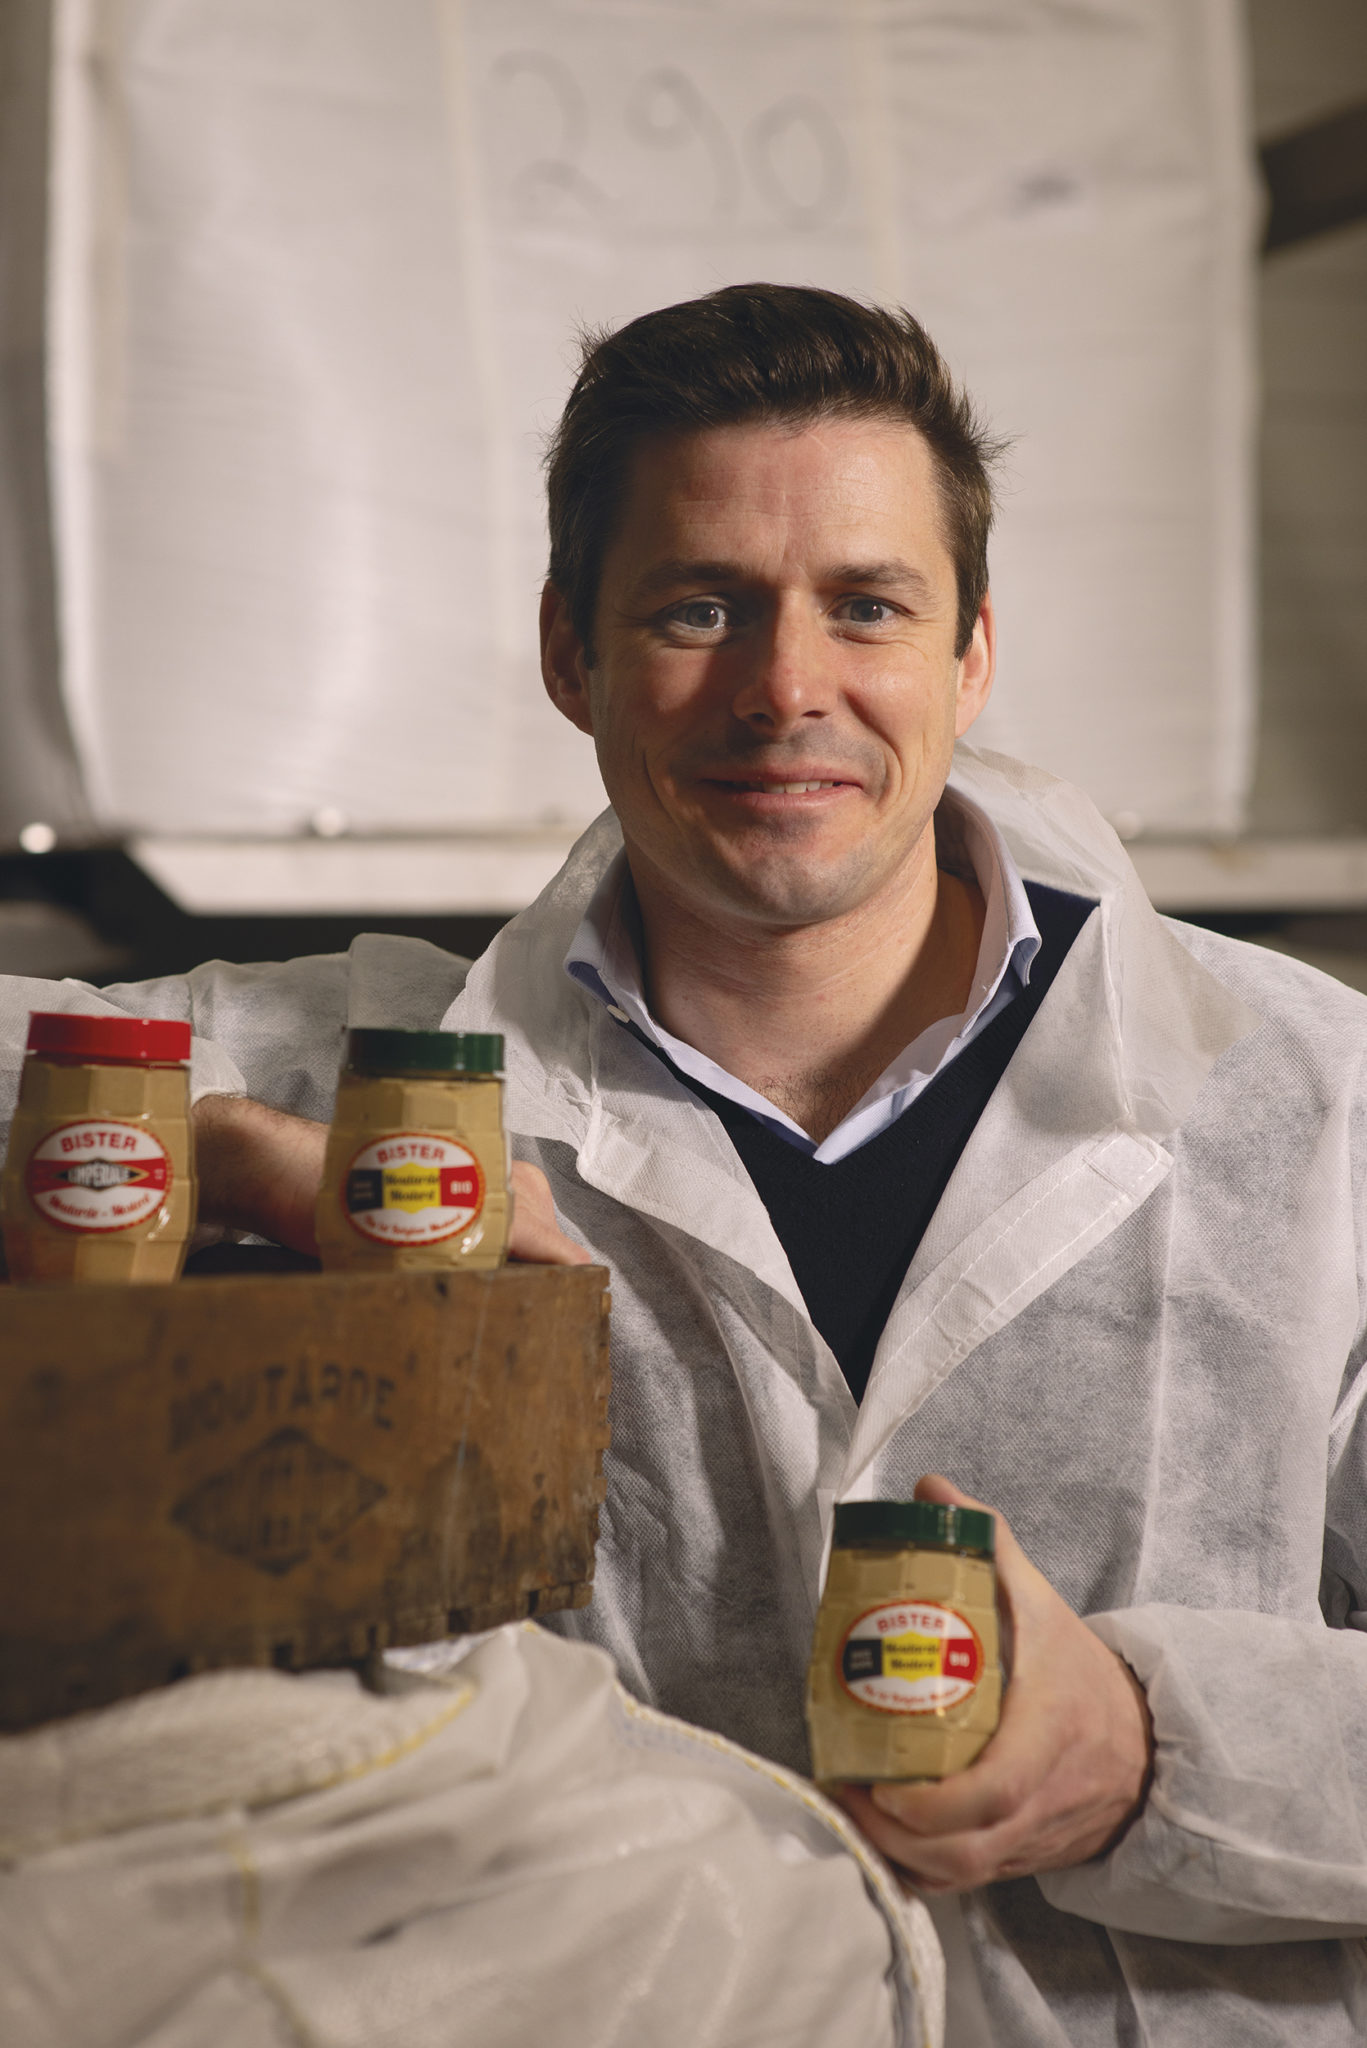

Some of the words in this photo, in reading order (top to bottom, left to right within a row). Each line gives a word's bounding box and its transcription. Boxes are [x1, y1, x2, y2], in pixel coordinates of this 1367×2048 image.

[490, 48, 850, 232] 290
[60, 1132, 138, 1153] BISTER
[377, 1144, 445, 1164] BISTER
[450, 1181, 473, 1195] BIO
[877, 1613, 945, 1633] BISTER
